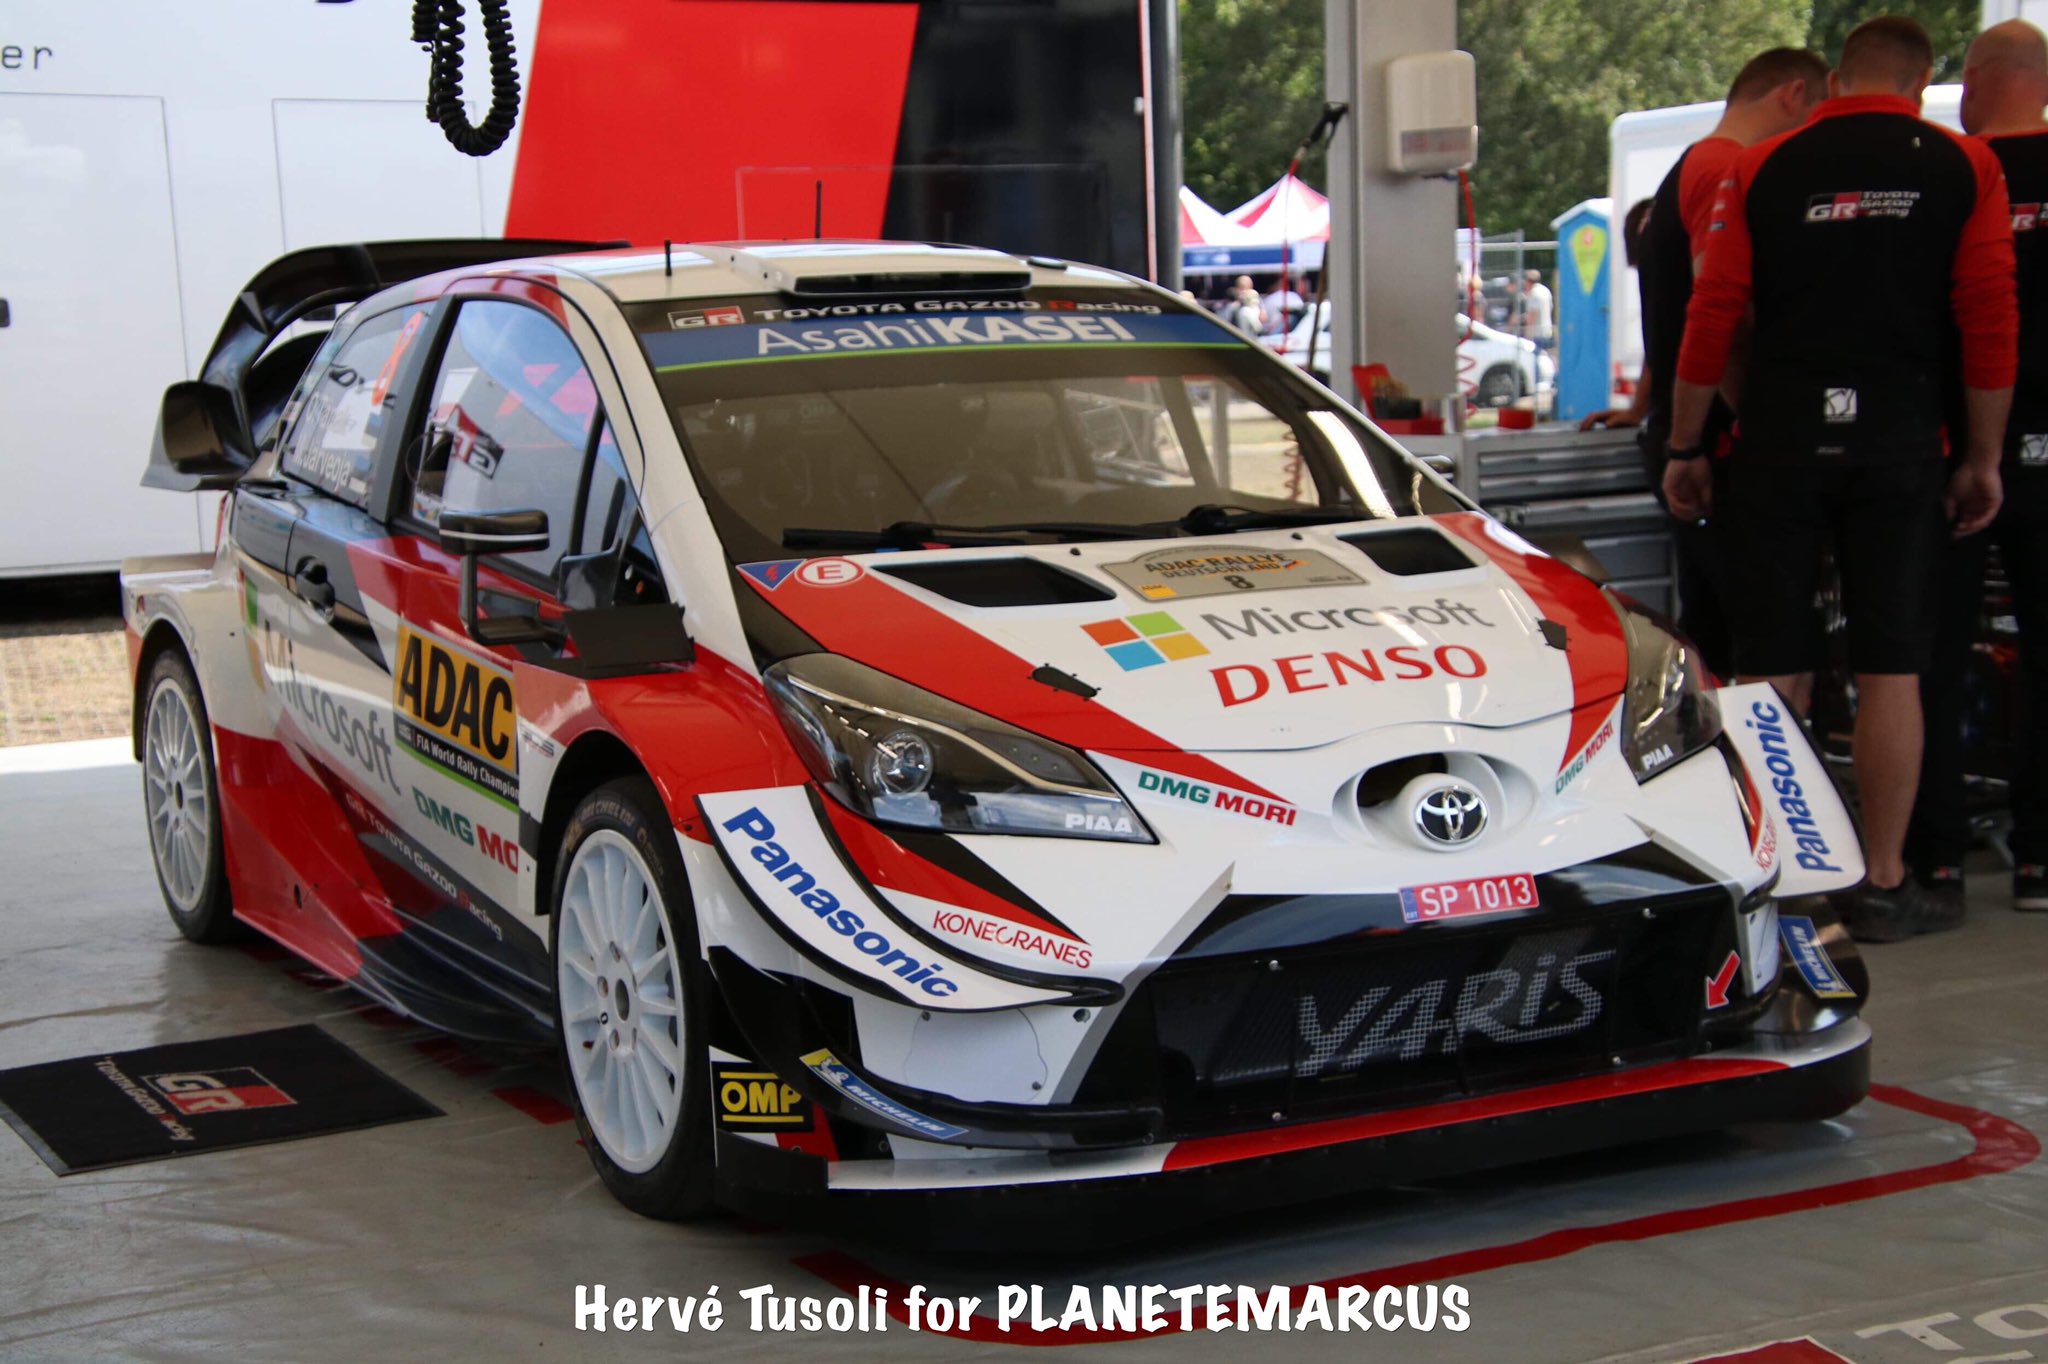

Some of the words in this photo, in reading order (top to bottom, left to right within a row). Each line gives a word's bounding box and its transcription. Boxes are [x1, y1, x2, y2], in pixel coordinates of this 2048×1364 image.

[1809, 203, 1857, 219] GR
[1861, 199, 1914, 207] GAZOO
[1863, 191, 1920, 199] TOYOTA
[674, 313, 741, 328] GR
[753, 303, 906, 321] TOYOTA
[914, 300, 1041, 311] GAZOO
[1048, 300, 1162, 314] Racing
[816, 564, 844, 580] E
[1145, 558, 1204, 573] ADAC
[1205, 552, 1291, 568] RALLYE
[1162, 561, 1283, 579] DEUTSCHLAND
[1224, 575, 1255, 589] 8
[1200, 597, 1497, 641] Microsoft
[1208, 643, 1489, 709] DENSO
[399, 634, 514, 761] ADAC
[415, 733, 431, 753] FIA
[431, 742, 456, 767] World
[457, 755, 479, 781] Rally
[1555, 753, 1585, 795] DMG
[1584, 719, 1614, 764] MORI
[1641, 743, 1675, 771] PIAA
[1136, 770, 1212, 805] DMG
[1213, 791, 1298, 827] MORI
[1745, 701, 1844, 873] Panasonic
[411, 786, 475, 847] DMG
[1064, 813, 1134, 834] PIAA
[412, 850, 458, 899] GAZOO
[721, 806, 959, 998] Panasonic
[1419, 884, 1460, 917] SP
[1466, 876, 1534, 911] 1013
[931, 908, 1094, 970] KONECRANES
[720, 1081, 802, 1114] OMP
[845, 1083, 947, 1132] MICHELIN
